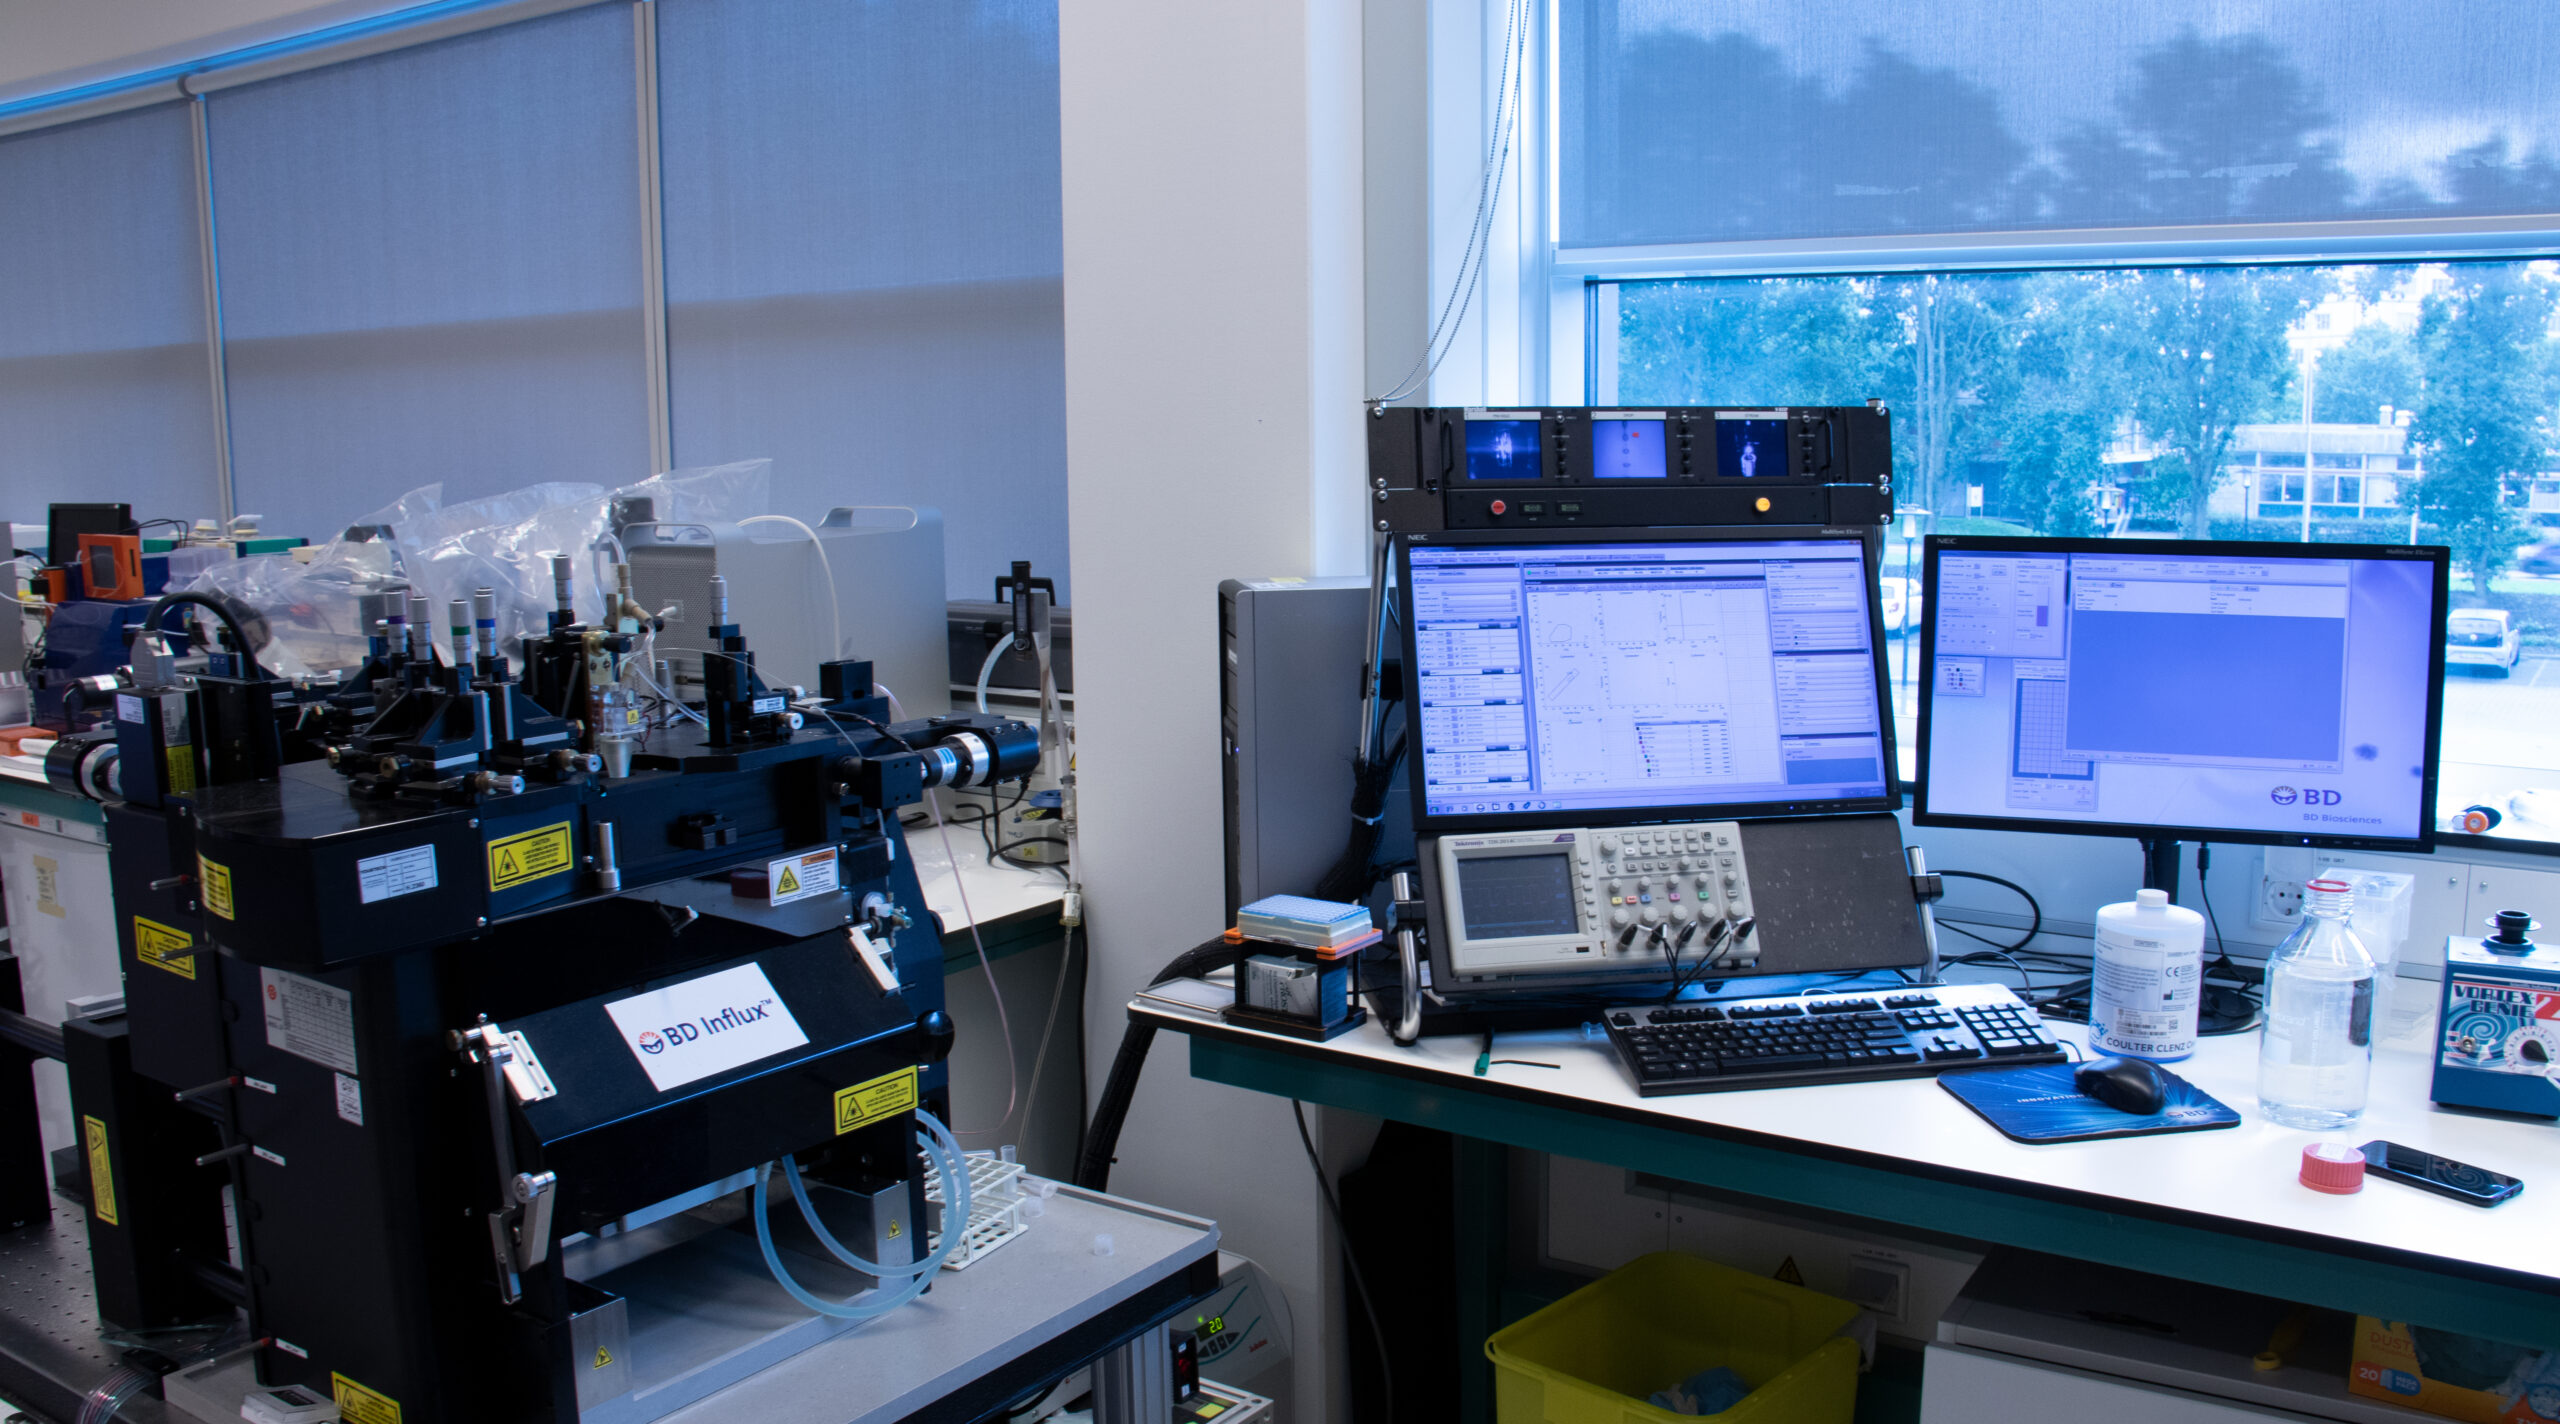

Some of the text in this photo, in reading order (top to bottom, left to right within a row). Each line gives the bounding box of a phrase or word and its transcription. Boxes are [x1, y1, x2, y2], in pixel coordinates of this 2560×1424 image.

[2303, 789, 2342, 806] BD
[2303, 813, 2382, 825] BD Biosciences
[2470, 999, 2535, 1019] GENIE
[661, 1022, 699, 1046] BD
[2106, 1037, 2154, 1053] COULTER
[2156, 1042, 2185, 1053] CLENZ
[2184, 1109, 2208, 1118] BD
[2359, 1367, 2378, 1382] 20
